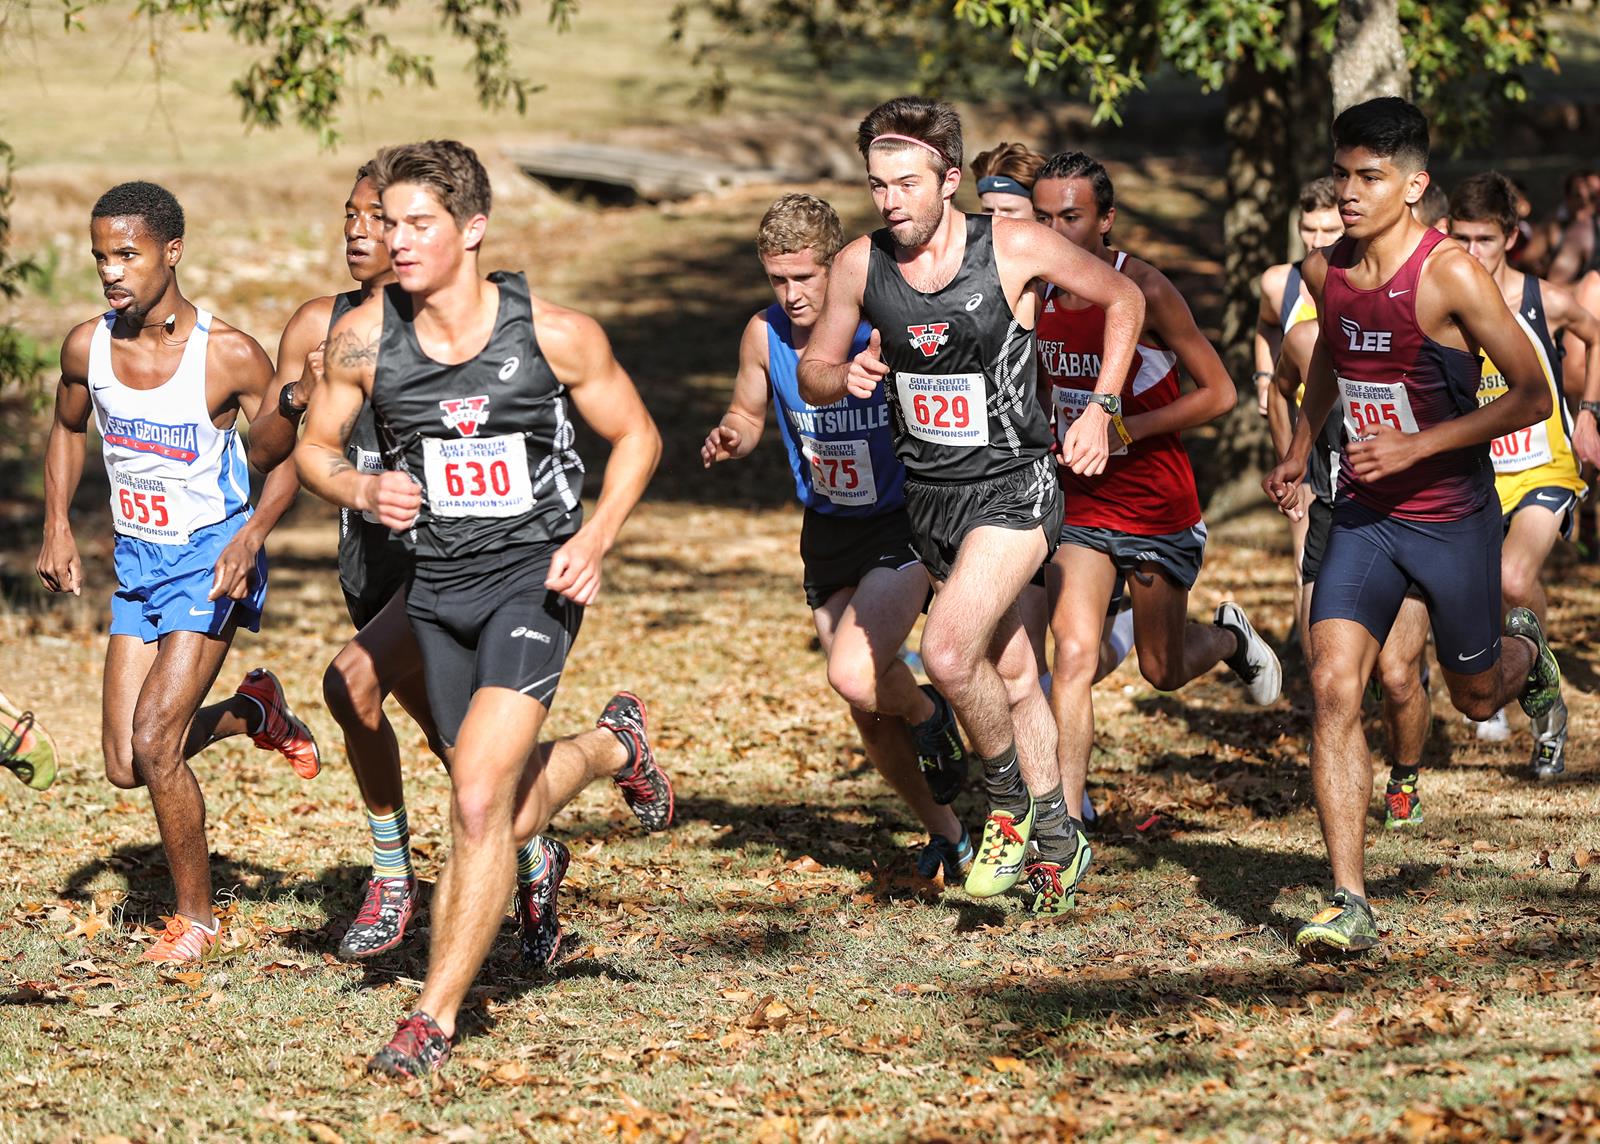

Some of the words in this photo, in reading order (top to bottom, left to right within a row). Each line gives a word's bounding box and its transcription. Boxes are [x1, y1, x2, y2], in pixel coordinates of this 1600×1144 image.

[916, 334, 941, 345] STATE
[1349, 331, 1392, 352] LEE
[1037, 340, 1064, 354] WEST
[1042, 353, 1101, 378] ALABA
[908, 383, 971, 392] CONFERENCE
[910, 377, 933, 385] GULF
[936, 378, 968, 386] SOUTH
[1345, 383, 1362, 392] GULF
[1345, 390, 1396, 400] CONFERENCE
[913, 394, 970, 428] 629
[133, 420, 196, 451] GEORGIA
[911, 425, 980, 438] CHAMPIONSHIP
[364, 455, 381, 463] GUL
[115, 476, 167, 493] CONFERENCE
[135, 477, 163, 487] SOUTH
[445, 460, 511, 497] 630
[119, 488, 169, 527] 655
[117, 519, 179, 537] CHAMPIONSHIP
